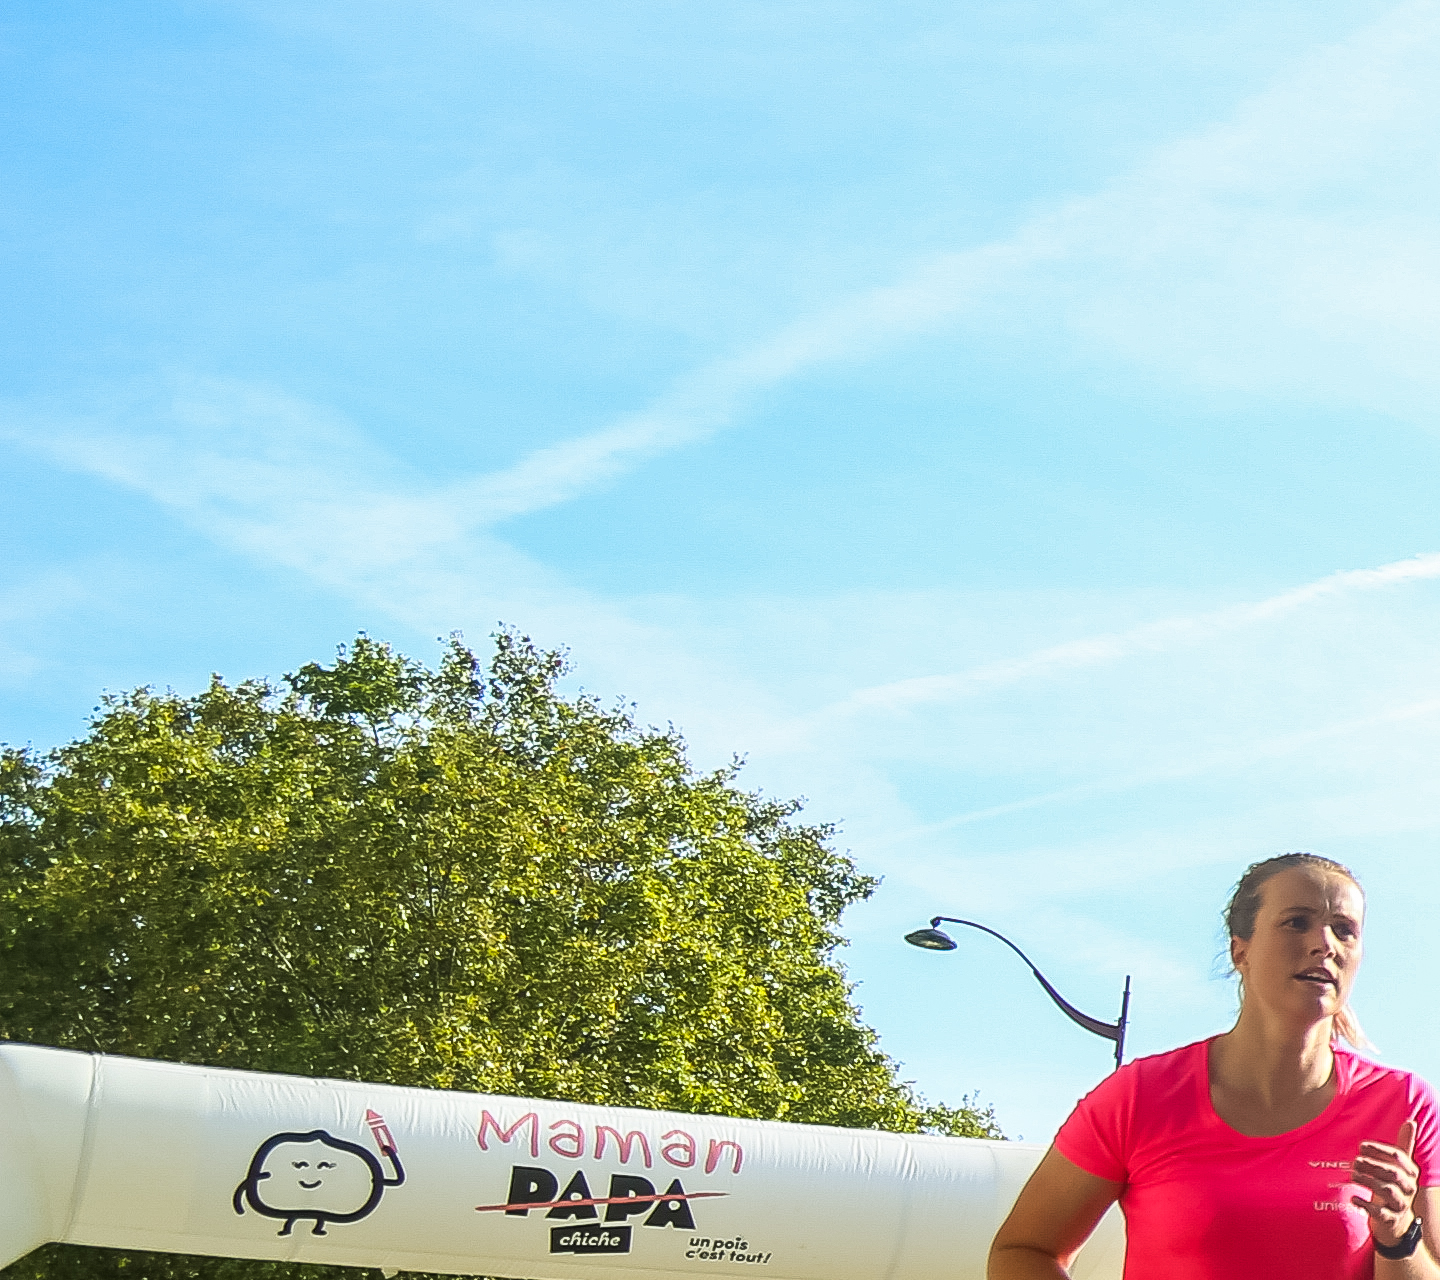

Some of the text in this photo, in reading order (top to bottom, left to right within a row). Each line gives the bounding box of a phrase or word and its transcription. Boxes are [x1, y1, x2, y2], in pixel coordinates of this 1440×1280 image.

[477, 1110, 743, 1174] Maman
[1308, 1161, 1351, 1169] VINC
[505, 1166, 696, 1230] PAPA
[559, 1231, 621, 1248] chiche
[689, 1236, 749, 1252] un pois
[685, 1248, 772, 1264] c'est tout!
